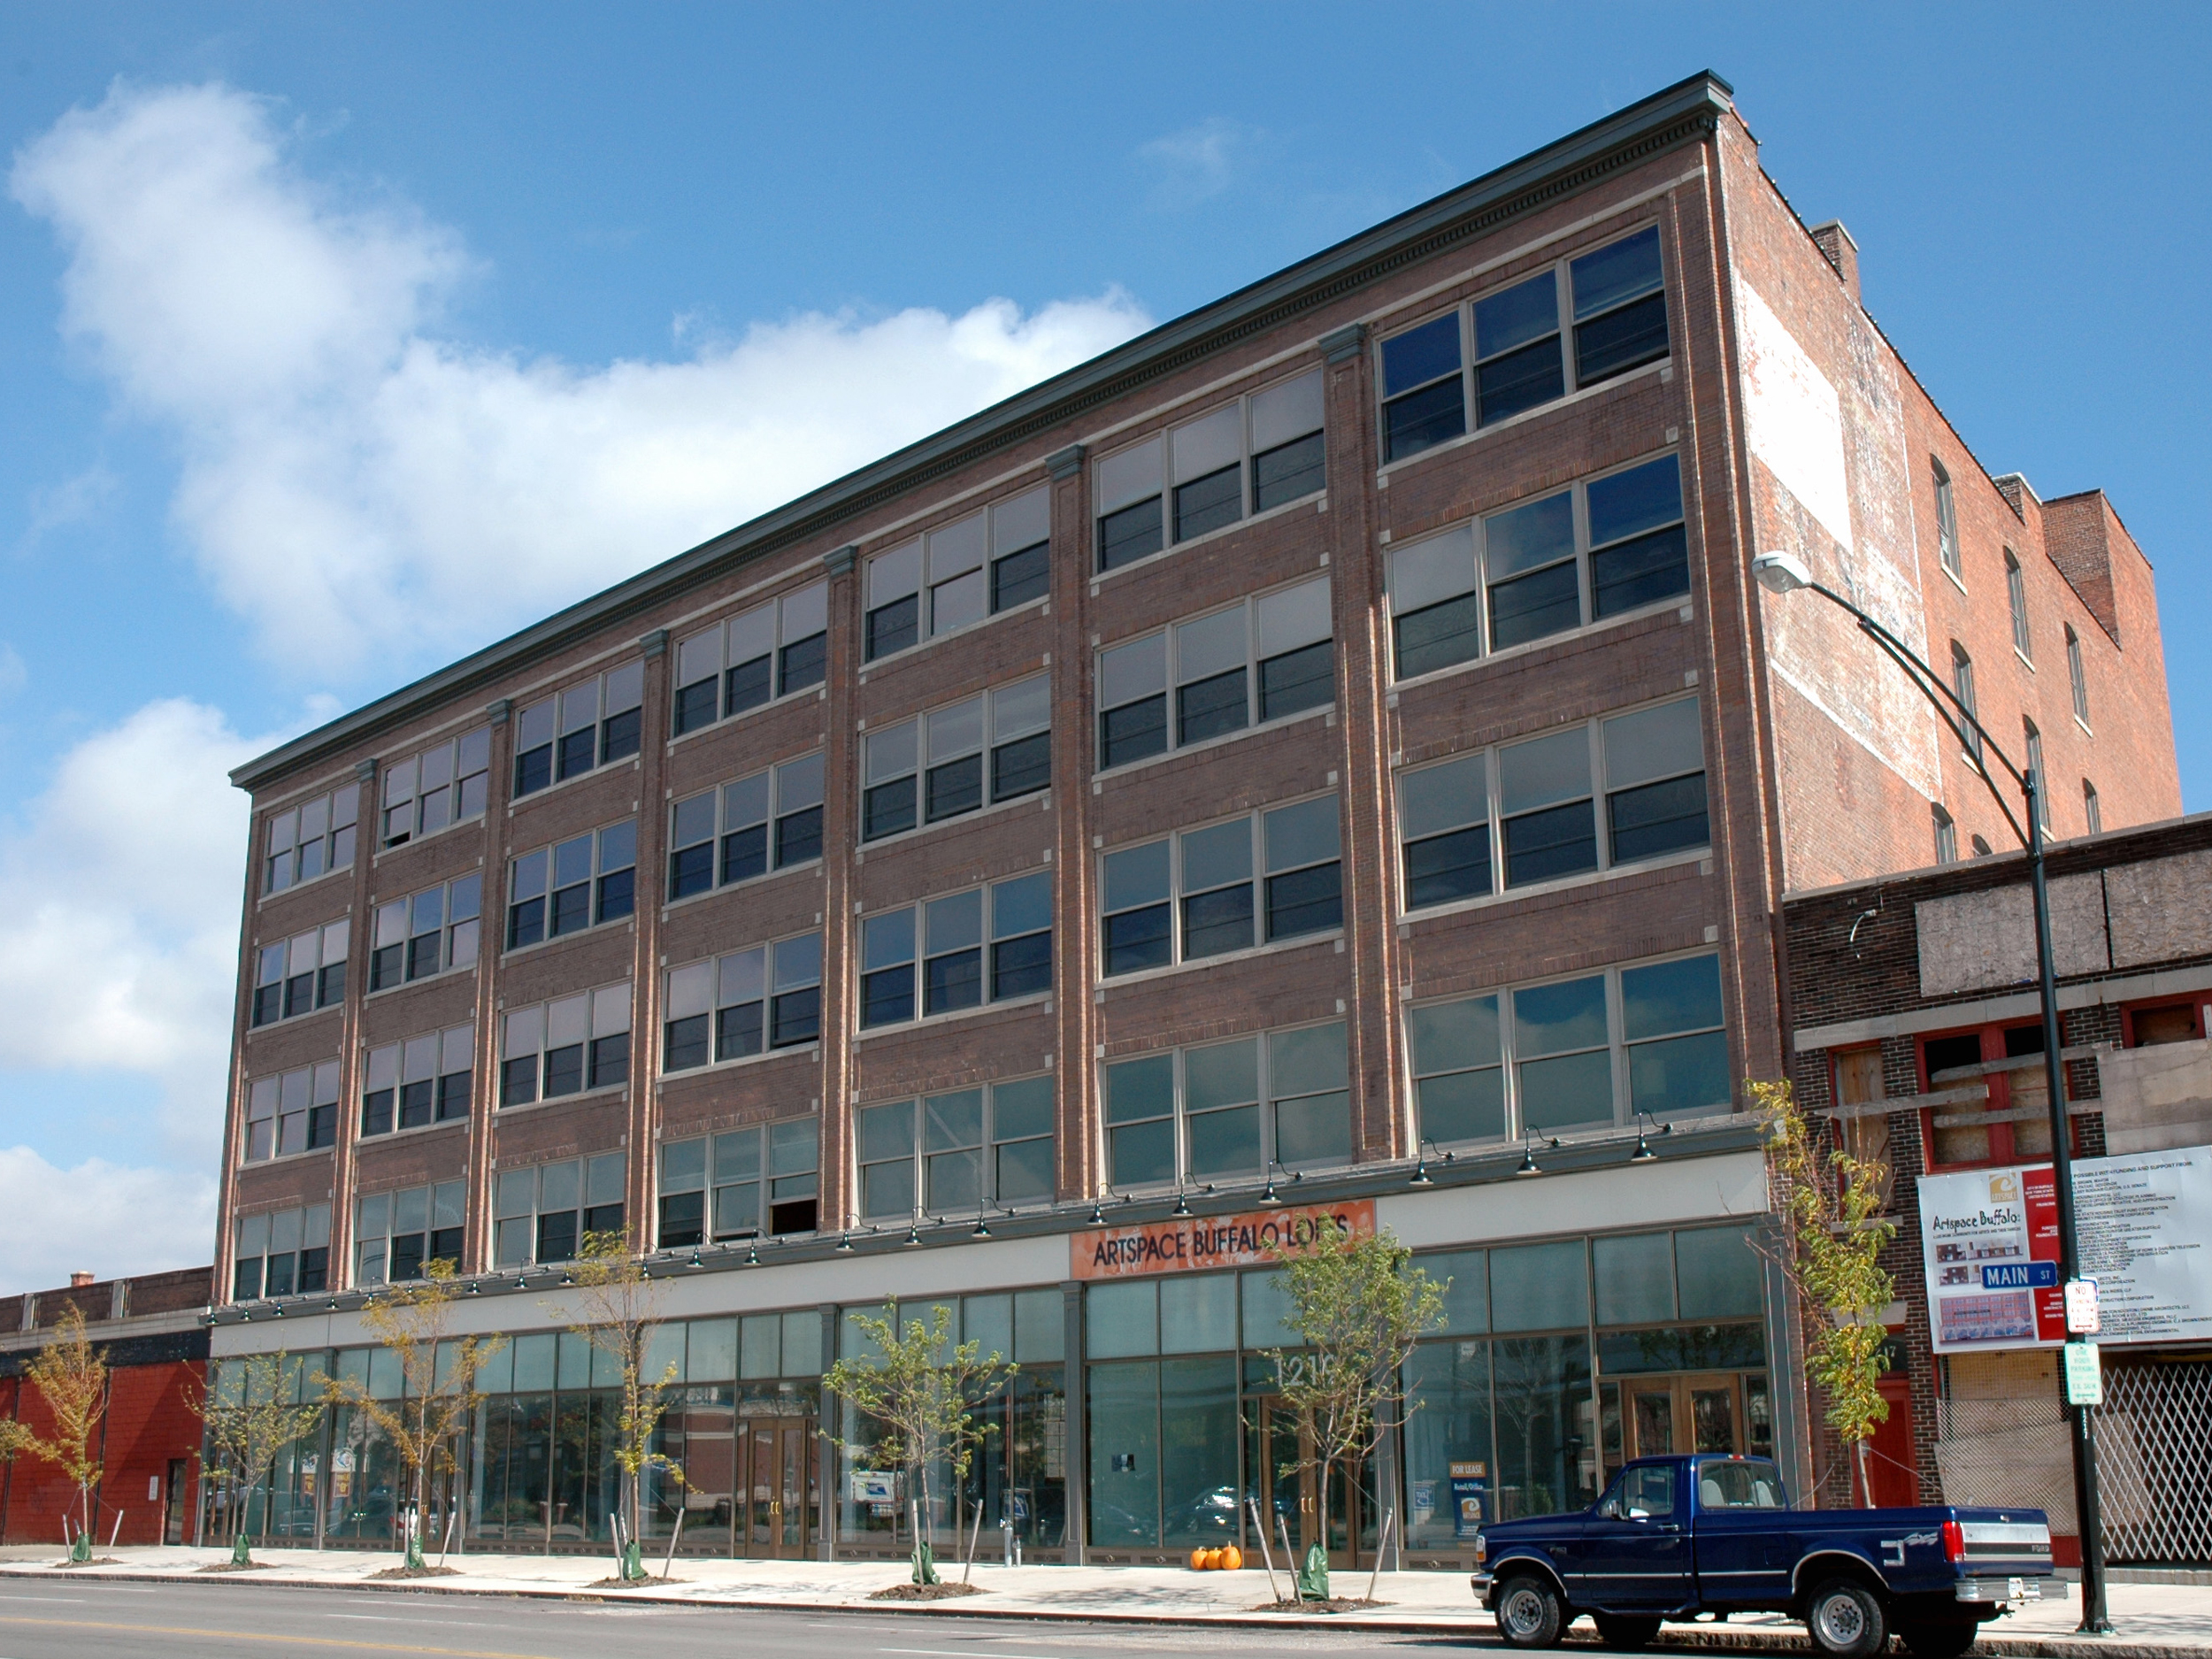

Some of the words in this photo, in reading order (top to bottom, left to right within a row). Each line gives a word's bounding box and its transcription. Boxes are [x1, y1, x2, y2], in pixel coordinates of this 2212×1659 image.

[1932, 1215, 1978, 1233] Artspace
[1094, 1232, 1186, 1267] ARTSPACE
[1193, 1222, 1279, 1256] BUFFALO
[1987, 1267, 2029, 1286] MAIN
[2040, 1271, 2050, 1279] ST
[2075, 1286, 2086, 1295] NO
[1452, 1465, 1464, 1474] FOR
[1465, 1464, 1482, 1474] LEASE
